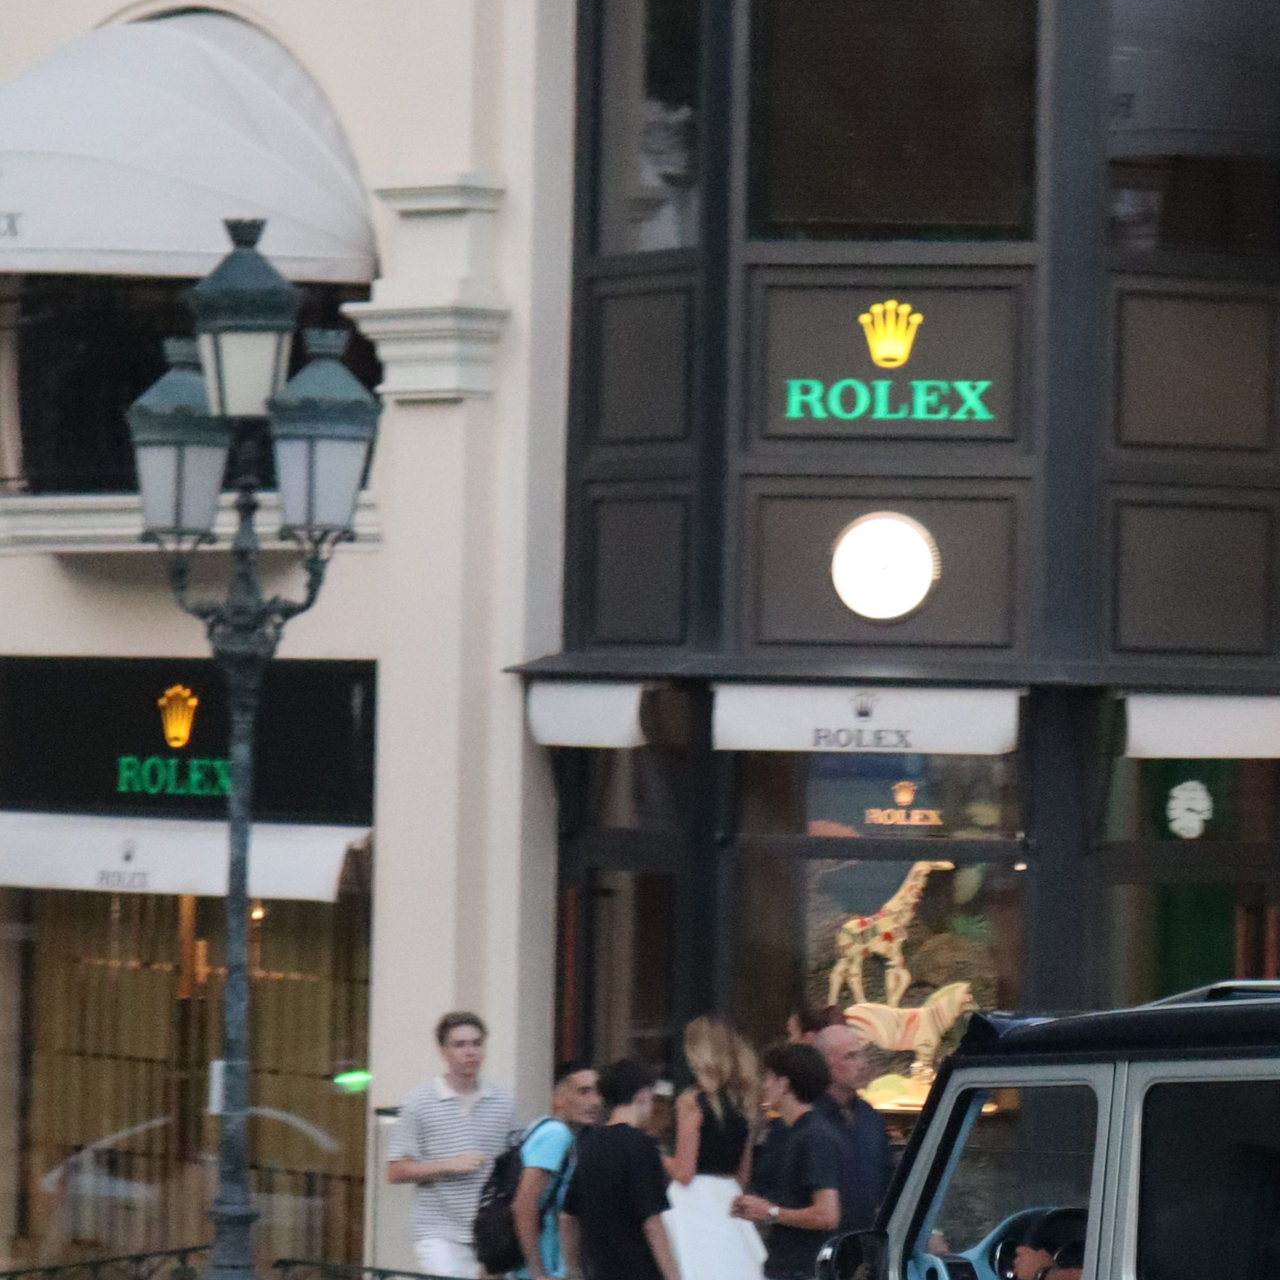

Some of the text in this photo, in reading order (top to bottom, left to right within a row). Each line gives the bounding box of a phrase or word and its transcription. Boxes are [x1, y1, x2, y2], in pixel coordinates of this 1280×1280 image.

[785, 378, 994, 420] ROLEX
[813, 727, 912, 748] ROLEX
[864, 807, 943, 825] ROLEX
